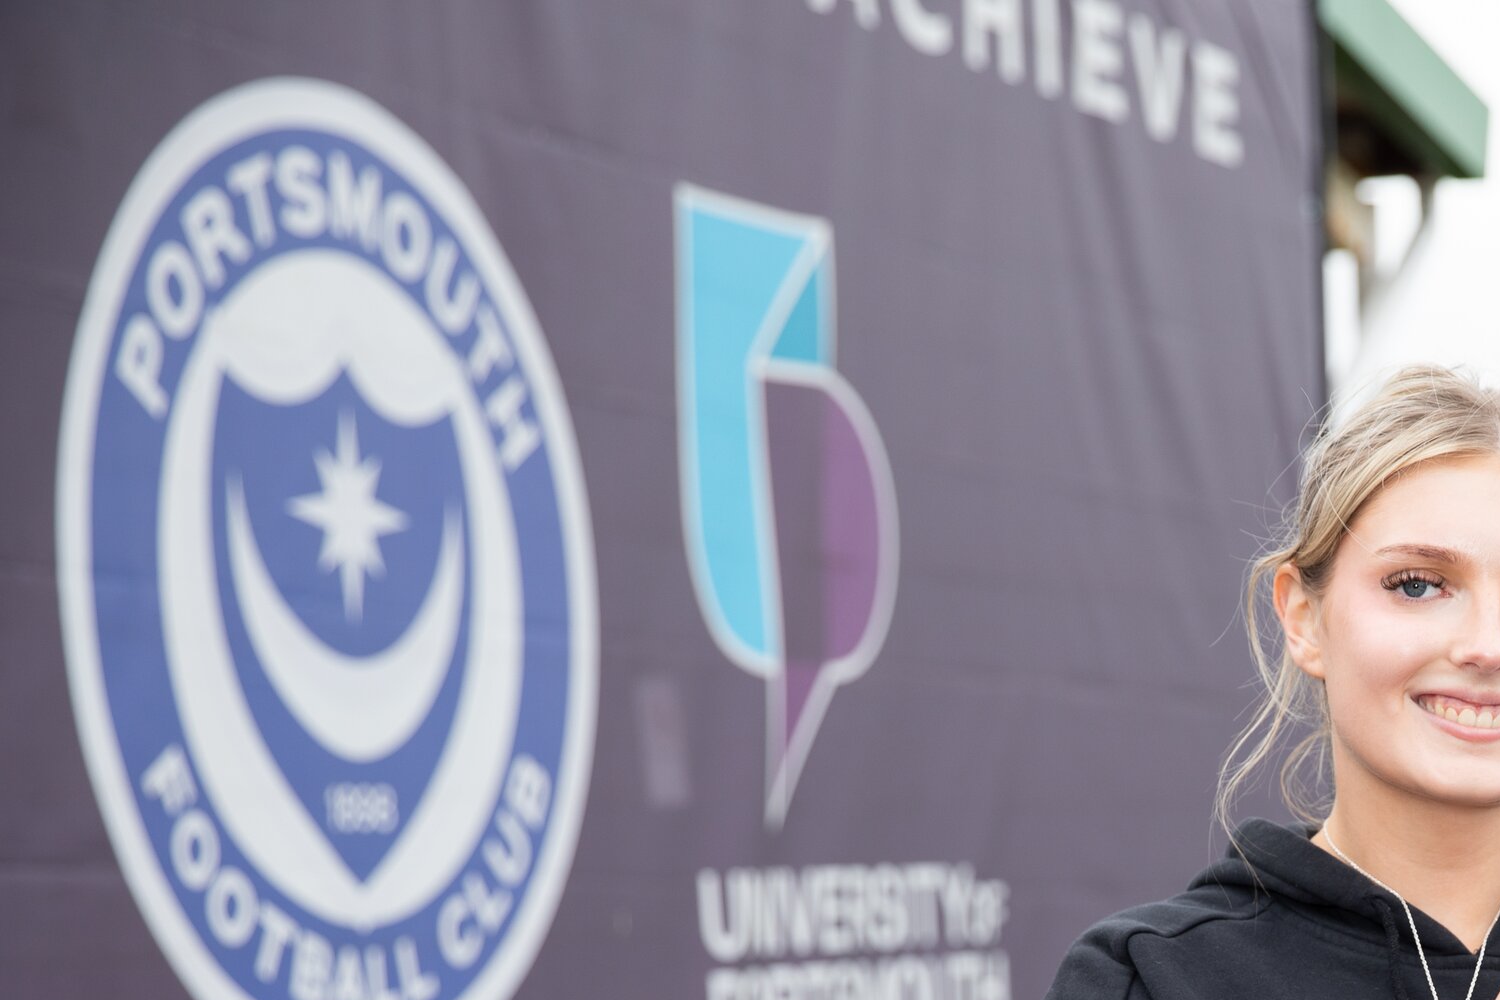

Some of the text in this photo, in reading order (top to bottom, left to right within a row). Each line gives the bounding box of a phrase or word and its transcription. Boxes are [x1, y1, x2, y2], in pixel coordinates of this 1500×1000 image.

[805, 0, 1245, 169] HIEVE
[115, 145, 545, 472] PORTSMOUTH
[437, 754, 552, 970] CLUB
[696, 862, 976, 962] UNIVERSITY
